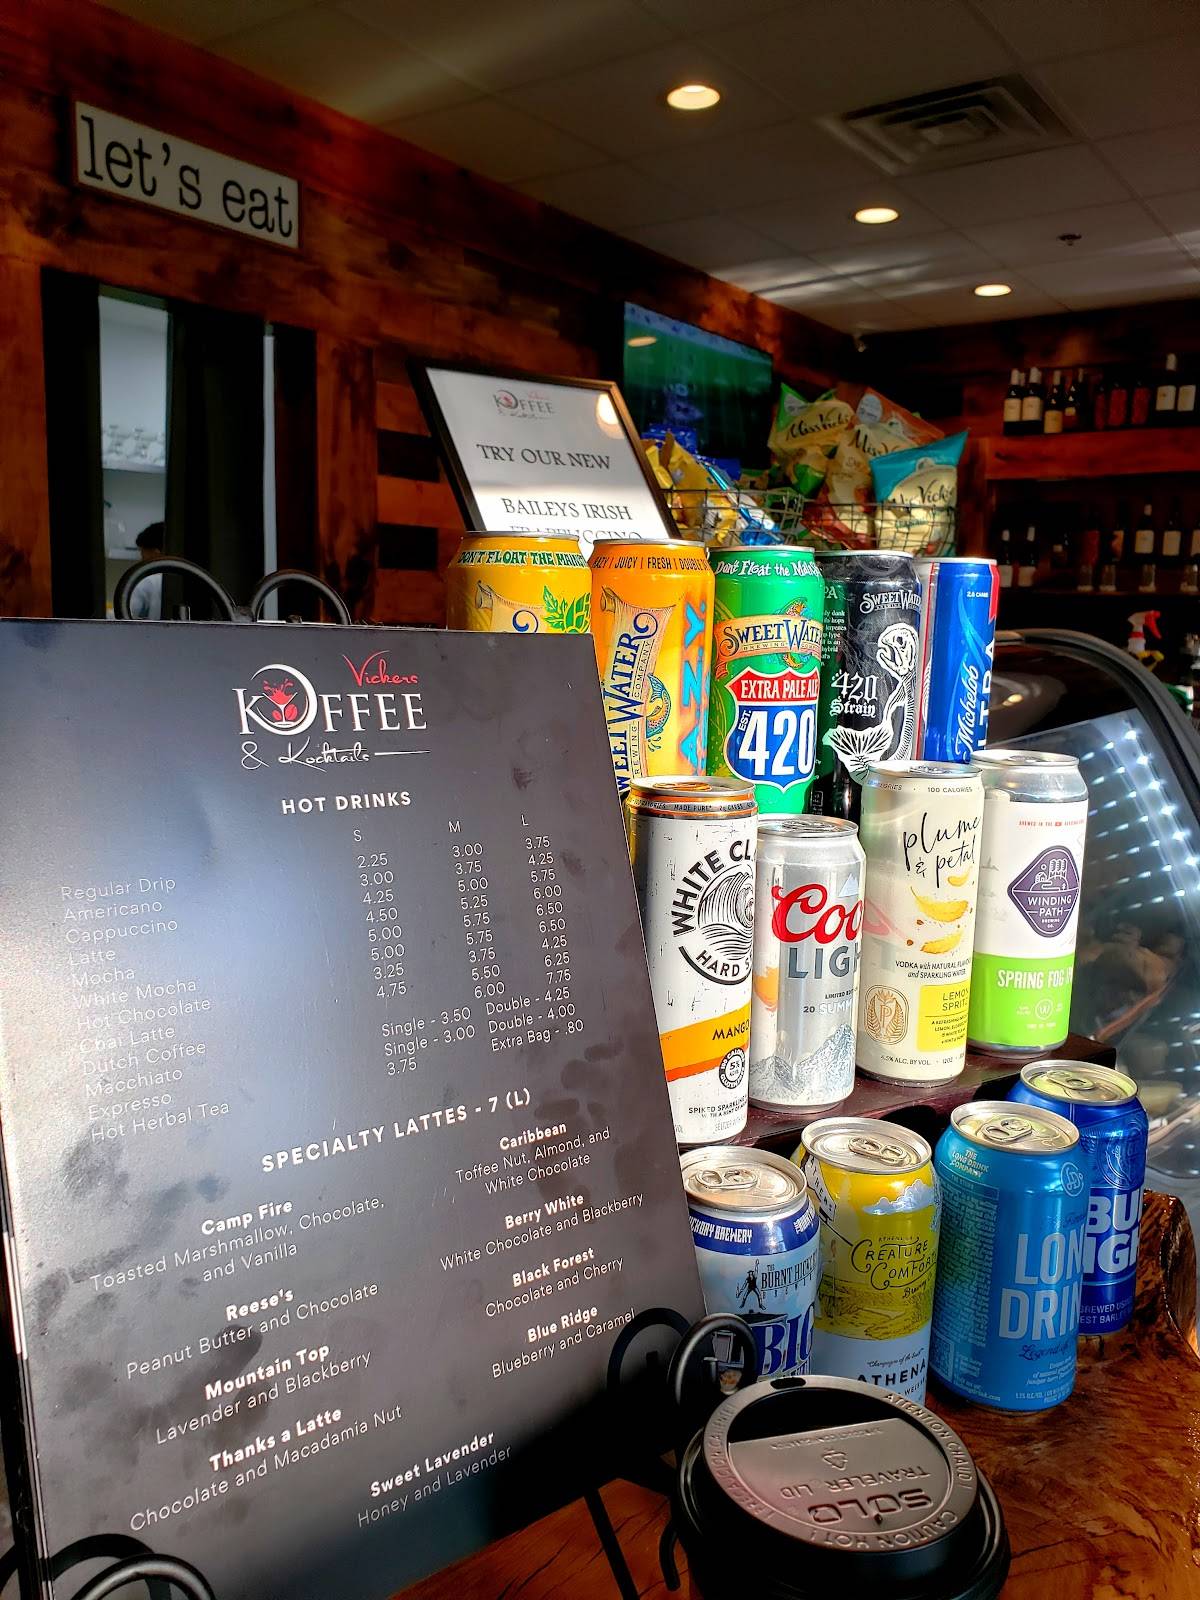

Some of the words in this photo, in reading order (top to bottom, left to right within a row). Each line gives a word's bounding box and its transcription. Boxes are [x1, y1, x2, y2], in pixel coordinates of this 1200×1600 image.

[81, 115, 202, 210] let's
[222, 180, 292, 238] eat
[476, 444, 516, 463] TRY
[521, 448, 567, 467] OUR
[568, 453, 611, 470] NEW
[502, 498, 580, 519] BAILEYS
[582, 503, 633, 520] IRISH
[486, 551, 528, 566] FLOAT
[530, 552, 554, 566] THE
[614, 556, 637, 569] JUICY
[648, 556, 672, 570] FRESH
[342, 649, 419, 687] Vickers
[232, 663, 428, 735] KOFFEE
[741, 680, 780, 699] EXTRA
[781, 680, 807, 699] PALE
[807, 680, 819, 699] ALE
[831, 669, 879, 703] 420
[829, 696, 876, 718] Strain
[955, 660, 979, 760] Michelob
[241, 740, 270, 770] &
[278, 736, 370, 772] Kocktails
[738, 709, 815, 776] 420
[282, 797, 326, 815] HOT
[335, 791, 412, 811] DRINKS
[353, 829, 363, 842] S
[903, 812, 981, 872] plume
[357, 853, 388, 868] 2.25
[915, 856, 927, 878] &
[936, 834, 976, 889] petal
[61, 881, 131, 902] Regular
[139, 877, 176, 893] Drip
[359, 871, 394, 887] 3.00
[671, 849, 725, 938] WHITE
[729, 838, 755, 862] CL
[63, 901, 163, 923] Americano
[363, 889, 394, 905] 4.25
[1028, 895, 1072, 908] WINDING
[1039, 907, 1064, 917] PATH
[366, 907, 398, 923] 4.50
[65, 920, 178, 944] Cappuccino
[369, 926, 402, 942] 5.00
[68, 949, 116, 967] Latte
[371, 944, 405, 961] 5.00
[696, 949, 741, 977] HARD
[895, 960, 919, 970] VODKA
[71, 968, 135, 988] Mocha
[373, 962, 404, 980] 3.25
[997, 969, 1044, 990] SPRING
[1048, 969, 1065, 989] FOG
[72, 990, 129, 1009] White
[136, 979, 197, 1000] Mocha
[376, 981, 407, 998] 4.75
[486, 995, 531, 1016] Double
[544, 988, 571, 1003] 4.25
[118, 998, 211, 1024] Chocolate
[382, 1019, 425, 1038] Single
[440, 1007, 471, 1025] 3.50
[489, 1014, 533, 1034] Double
[547, 1003, 576, 1020] 4.00
[79, 1036, 122, 1054] Chai
[130, 1027, 176, 1046] Latte
[384, 1037, 428, 1057] Single
[444, 1025, 475, 1043] 3.00
[491, 1035, 523, 1052] Extra
[527, 1028, 551, 1043] Bag
[564, 1019, 584, 1035] .80
[712, 1019, 750, 1041] MANGO
[83, 1054, 138, 1075] Dutch
[146, 1042, 206, 1063] Coffee
[387, 1057, 417, 1076] 3.75
[85, 1069, 183, 1098] Macchiato
[88, 1093, 172, 1120] Expresso
[91, 1124, 125, 1142] Hot
[133, 1107, 192, 1134] Herbal
[198, 1102, 230, 1119] Tea
[262, 1125, 386, 1173] SPECIALTY
[394, 1105, 467, 1138] LATTES
[488, 1096, 498, 1113] 7
[506, 1087, 531, 1110] (L)
[499, 1122, 567, 1150] Caribbean
[455, 1160, 499, 1184] Toffee
[503, 1152, 530, 1171] Nut,
[534, 1136, 585, 1162] Almond,
[588, 1126, 611, 1145] and
[484, 1174, 523, 1196] White
[527, 1153, 591, 1182] Chocolate
[201, 1211, 253, 1236] Camp
[258, 1200, 293, 1220] Fire
[505, 1207, 542, 1230] Berry
[544, 1194, 584, 1217] White
[89, 1254, 167, 1292] Toasted
[174, 1223, 294, 1268] Marshmallow,
[299, 1196, 385, 1230] Chocolate,
[440, 1249, 481, 1272] White
[485, 1224, 552, 1256] Chocolate
[556, 1211, 579, 1232] and
[582, 1193, 645, 1223] Blackberry
[714, 1226, 753, 1244] BREWERY
[202, 1259, 236, 1283] and
[242, 1242, 297, 1271] Vanilla
[512, 1265, 550, 1288] Black
[553, 1247, 595, 1272] Forest
[851, 1236, 929, 1274] CREATURE
[485, 1285, 552, 1317] Chocolate
[556, 1274, 580, 1293] and
[583, 1256, 624, 1280] Cherry
[225, 1288, 295, 1322] Reese's
[126, 1345, 193, 1379] Peanut
[200, 1325, 253, 1354] Butter
[259, 1314, 291, 1333] and
[296, 1283, 379, 1320] Chocolate
[527, 1323, 557, 1343] Blue
[560, 1305, 598, 1330] Ridge
[492, 1344, 555, 1378] Blueberry
[560, 1330, 583, 1350] and
[586, 1308, 636, 1338] Caramel
[205, 1358, 292, 1400] Mountain
[297, 1344, 330, 1366] Top
[156, 1401, 240, 1445] Lavender
[247, 1386, 279, 1408] and
[285, 1352, 372, 1394] Blackberry
[209, 1437, 275, 1472] Thanks
[281, 1430, 291, 1443] a
[296, 1408, 342, 1436] Latte
[129, 1482, 229, 1531] Chocolate
[235, 1460, 268, 1486] and
[274, 1422, 368, 1470] Macadamia
[374, 1405, 402, 1427] Nut
[370, 1465, 421, 1497] Sweet
[425, 1432, 494, 1473] Lavender
[825, 1465, 930, 1493] TRAVELER
[358, 1496, 409, 1527] Honey
[414, 1477, 442, 1500] and
[447, 1446, 512, 1485] Lavender
[781, 1484, 812, 1498] LID
[807, 1488, 932, 1524] SOLO
[879, 1511, 958, 1549] CAUTION
